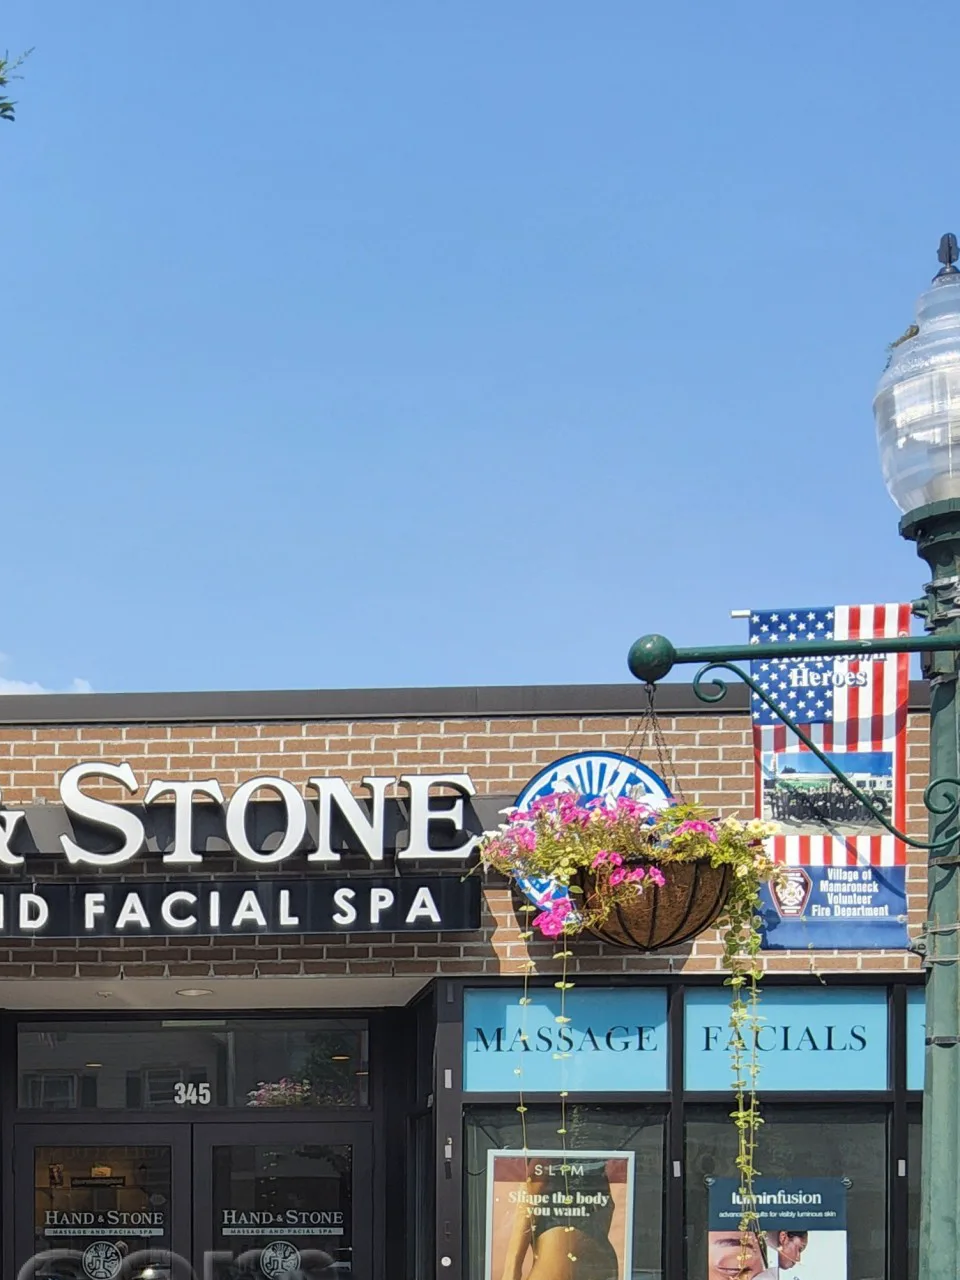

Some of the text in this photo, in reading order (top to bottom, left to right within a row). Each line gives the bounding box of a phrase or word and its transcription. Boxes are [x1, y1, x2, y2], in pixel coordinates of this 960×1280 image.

[790, 667, 867, 688] Heroes
[58, 761, 478, 865] STONE
[828, 868, 858, 881] Village
[820, 880, 879, 893] Mamaroneck
[827, 893, 873, 904] Volunteer
[84, 889, 300, 929] FACIAL
[332, 886, 441, 926] SPA
[812, 904, 830, 917] Fire
[834, 904, 889, 917] Department
[473, 1025, 658, 1052] MASSAGE
[701, 1024, 868, 1052] FACIALS
[173, 1082, 211, 1105] 345
[507, 1190, 610, 1207] Shape the body
[44, 1210, 164, 1225] HAND & STONE
[222, 1209, 344, 1225] HAND & STONE
[525, 1206, 590, 1218] you want.
